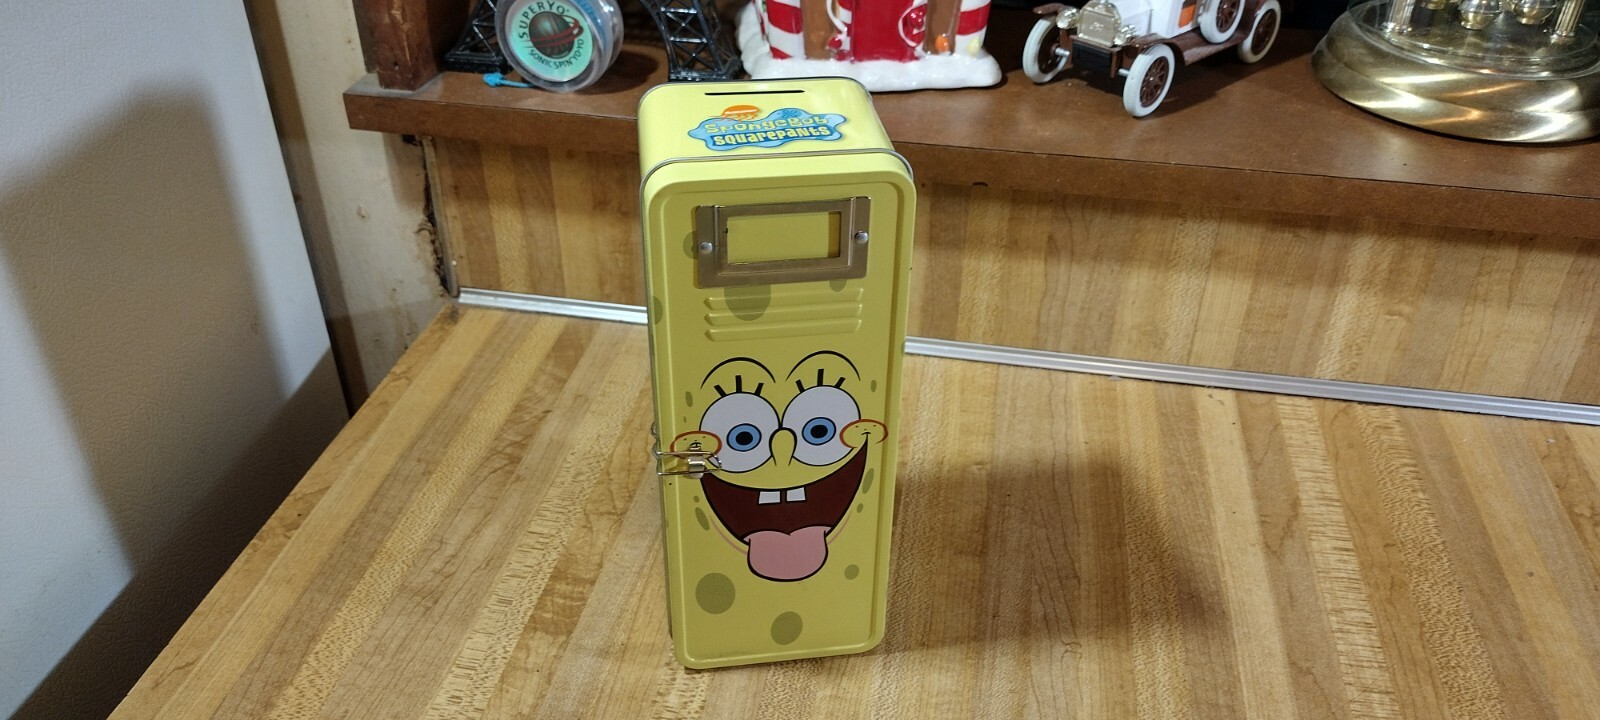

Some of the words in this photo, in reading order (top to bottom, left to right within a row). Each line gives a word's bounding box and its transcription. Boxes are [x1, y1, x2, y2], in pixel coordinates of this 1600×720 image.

[528, 49, 553, 68] SONIC
[553, 59, 573, 69] SPIN
[704, 116, 828, 134] SpongeBob
